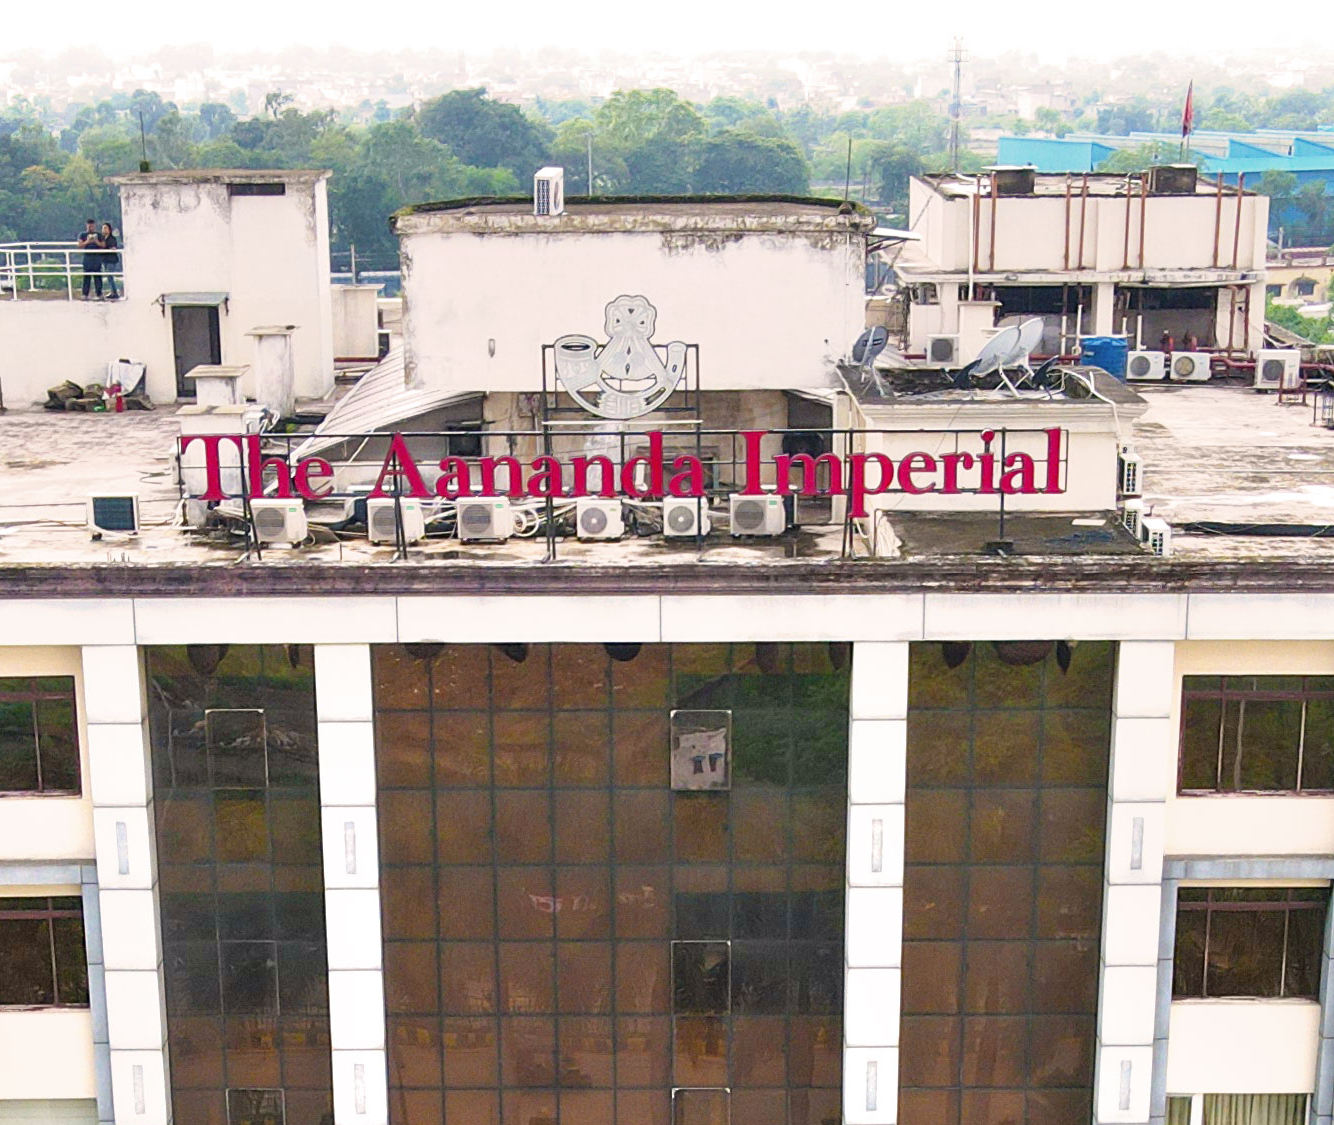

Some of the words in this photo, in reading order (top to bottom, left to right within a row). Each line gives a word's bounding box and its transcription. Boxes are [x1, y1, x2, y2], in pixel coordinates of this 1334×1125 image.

[180, 433, 335, 501] The
[366, 431, 706, 499] Aananda
[740, 427, 1067, 519] Imperial
